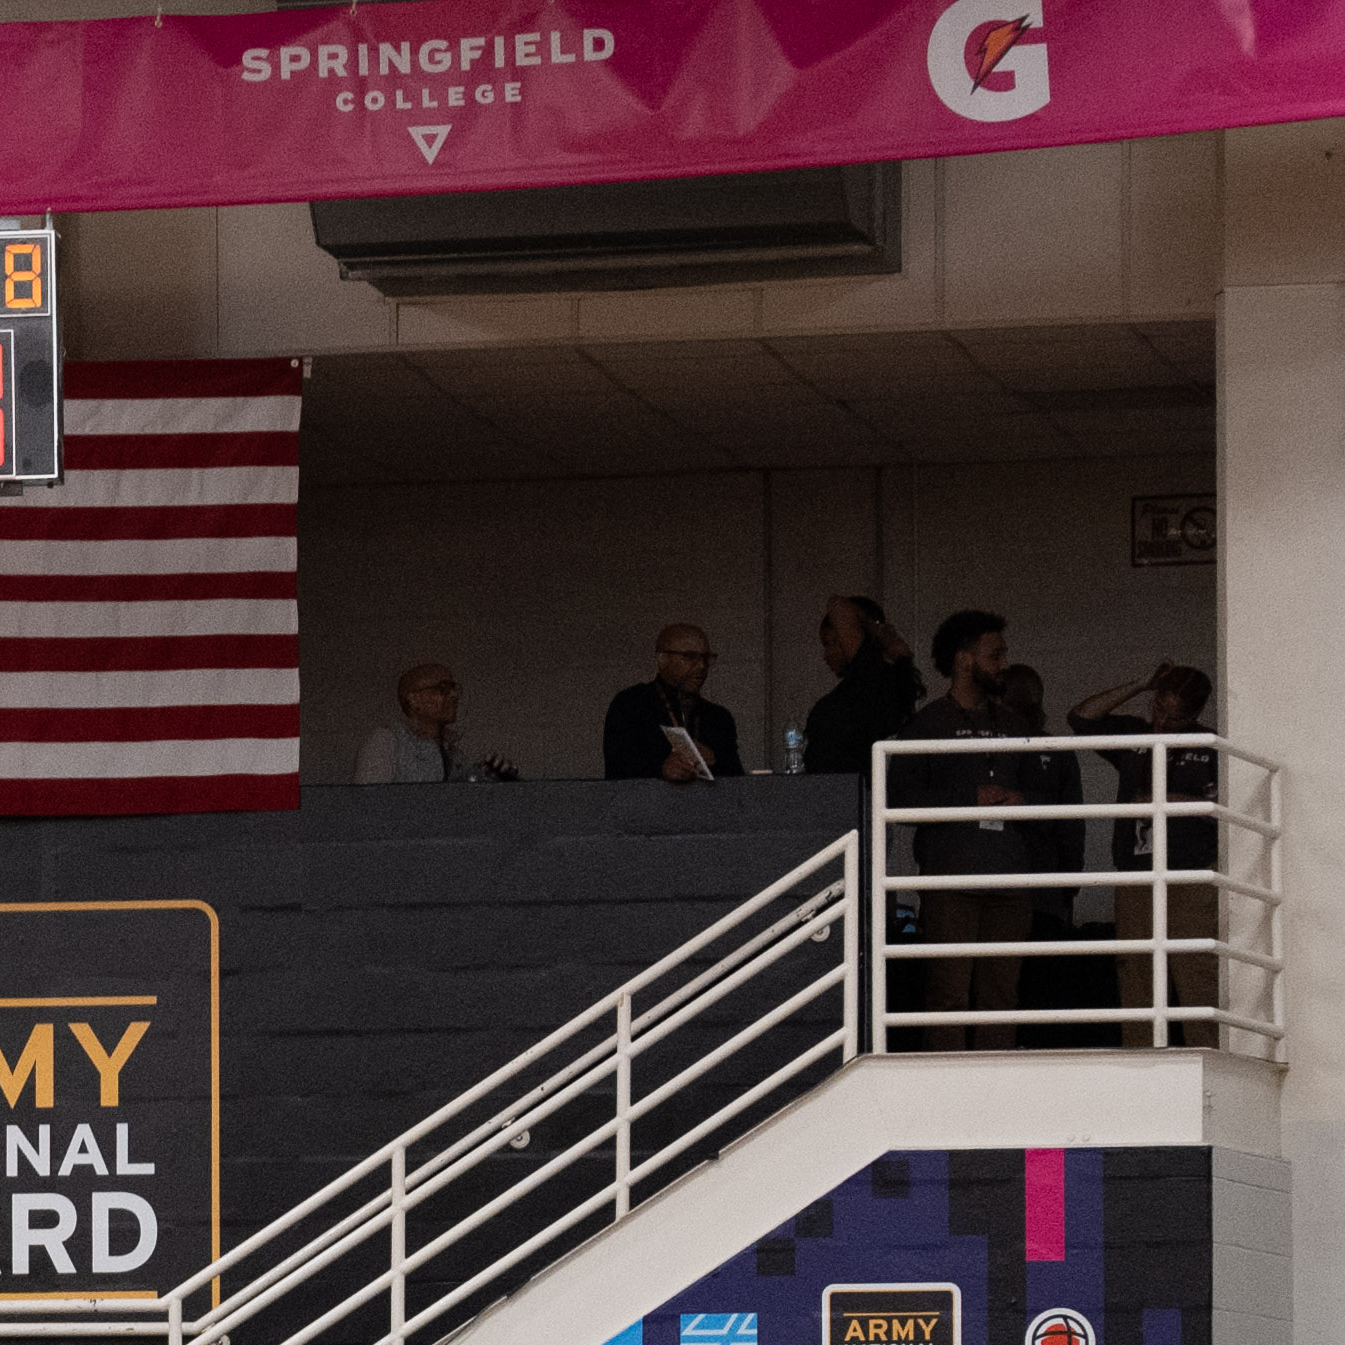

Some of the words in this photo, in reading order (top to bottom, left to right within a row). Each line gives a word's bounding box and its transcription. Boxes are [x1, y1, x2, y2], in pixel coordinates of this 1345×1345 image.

[240, 27, 617, 84] SPRINGFIELD
[335, 80, 523, 112] COLLEGE
[843, 1316, 939, 1341] ARMY
